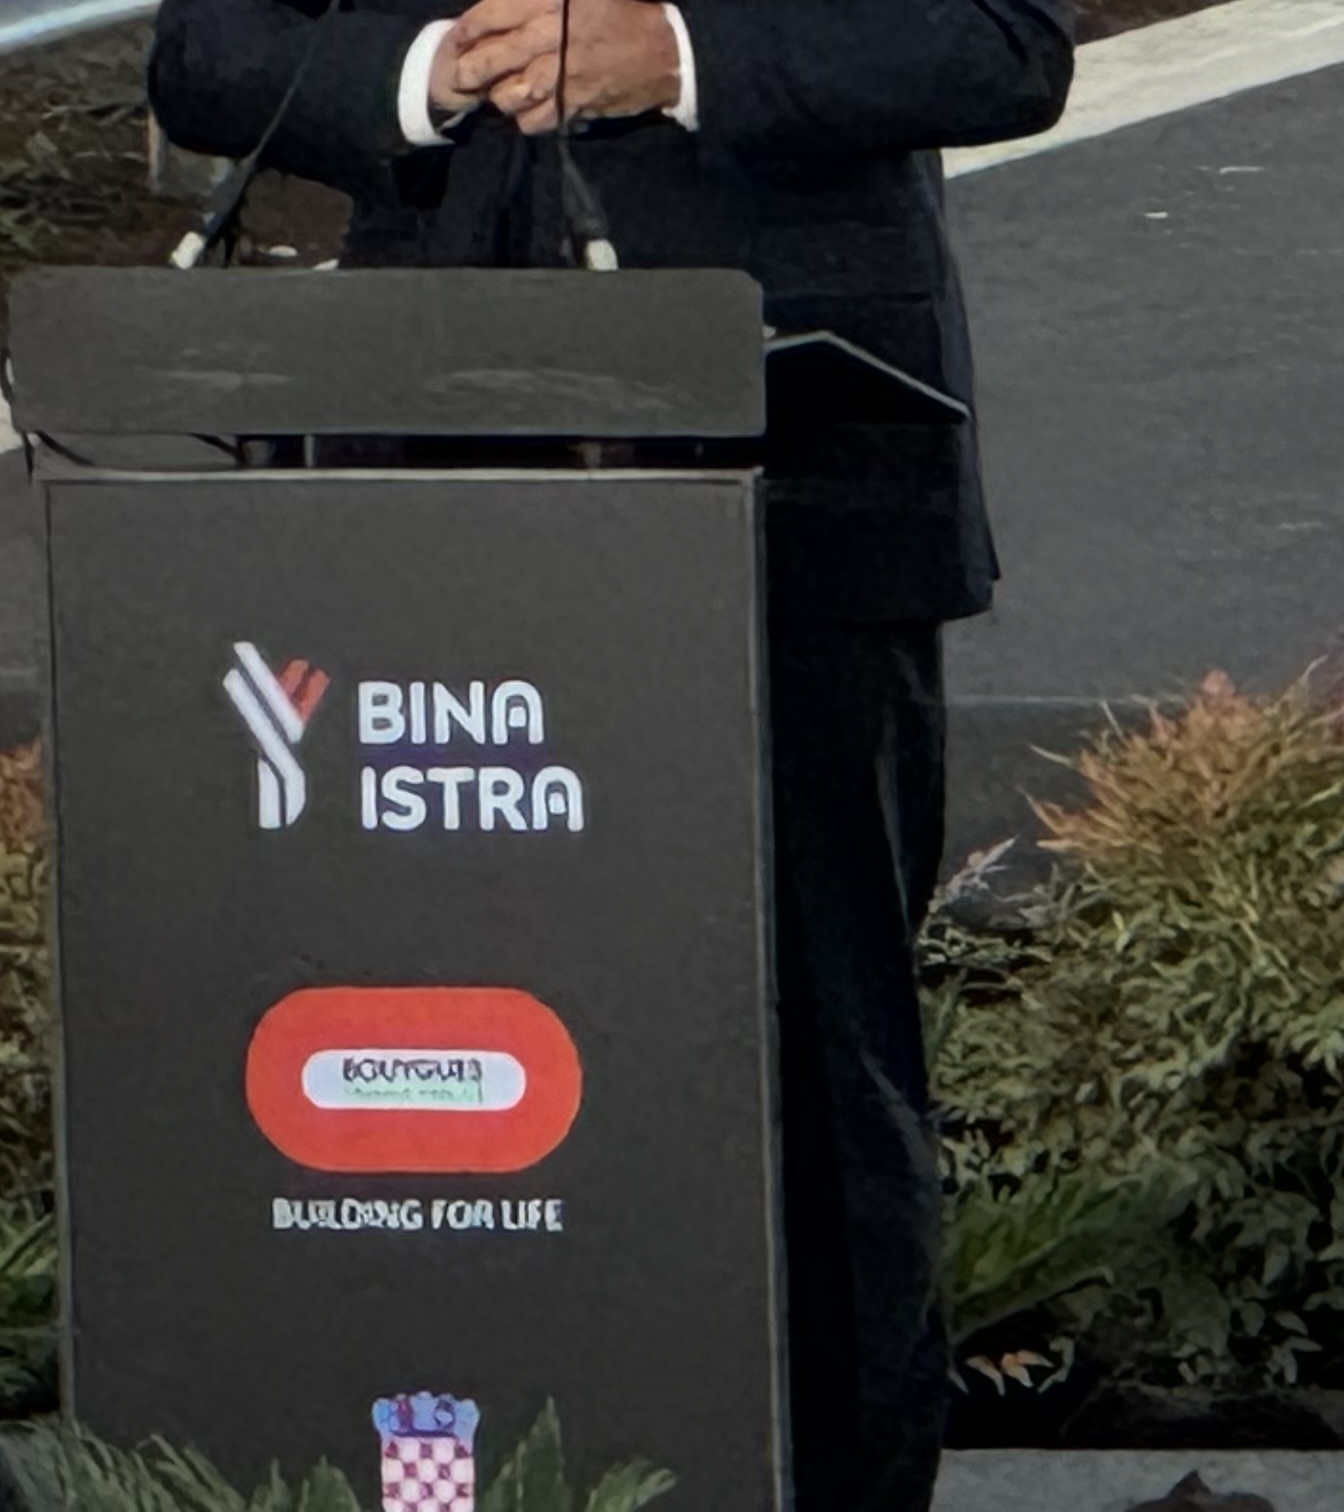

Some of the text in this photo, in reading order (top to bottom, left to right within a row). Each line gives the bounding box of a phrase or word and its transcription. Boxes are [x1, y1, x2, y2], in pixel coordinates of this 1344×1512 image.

[358, 680, 544, 745] BINA
[361, 766, 584, 831] ISTRA
[273, 1198, 563, 1231] BUILDING FOR LIFE
